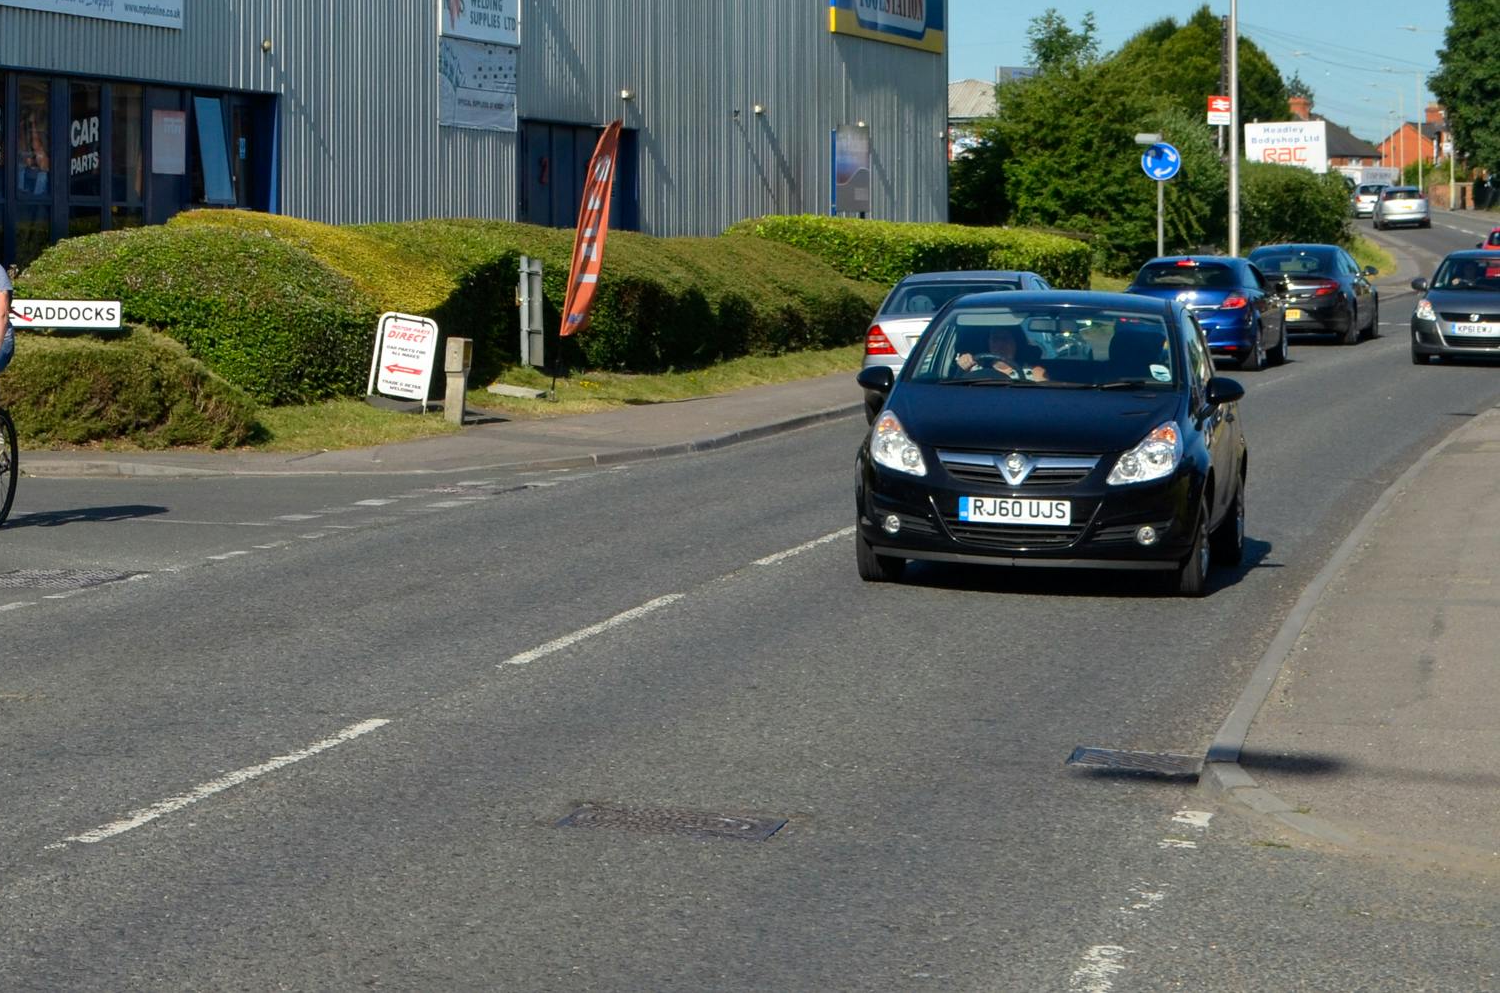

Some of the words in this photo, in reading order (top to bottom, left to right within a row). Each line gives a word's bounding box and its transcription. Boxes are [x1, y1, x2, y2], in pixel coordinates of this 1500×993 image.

[469, 11, 500, 29] SUPPLIES
[504, 16, 517, 31] LTD
[70, 116, 100, 147] CAR
[1263, 126, 1304, 134] Headley
[1251, 137, 1300, 145] Bodyshop
[70, 151, 100, 175] PARTS
[23, 306, 116, 321] PADDOCKS
[387, 330, 427, 343] DIRECT
[973, 498, 1022, 517] RJ60
[1029, 501, 1066, 519] UJS
